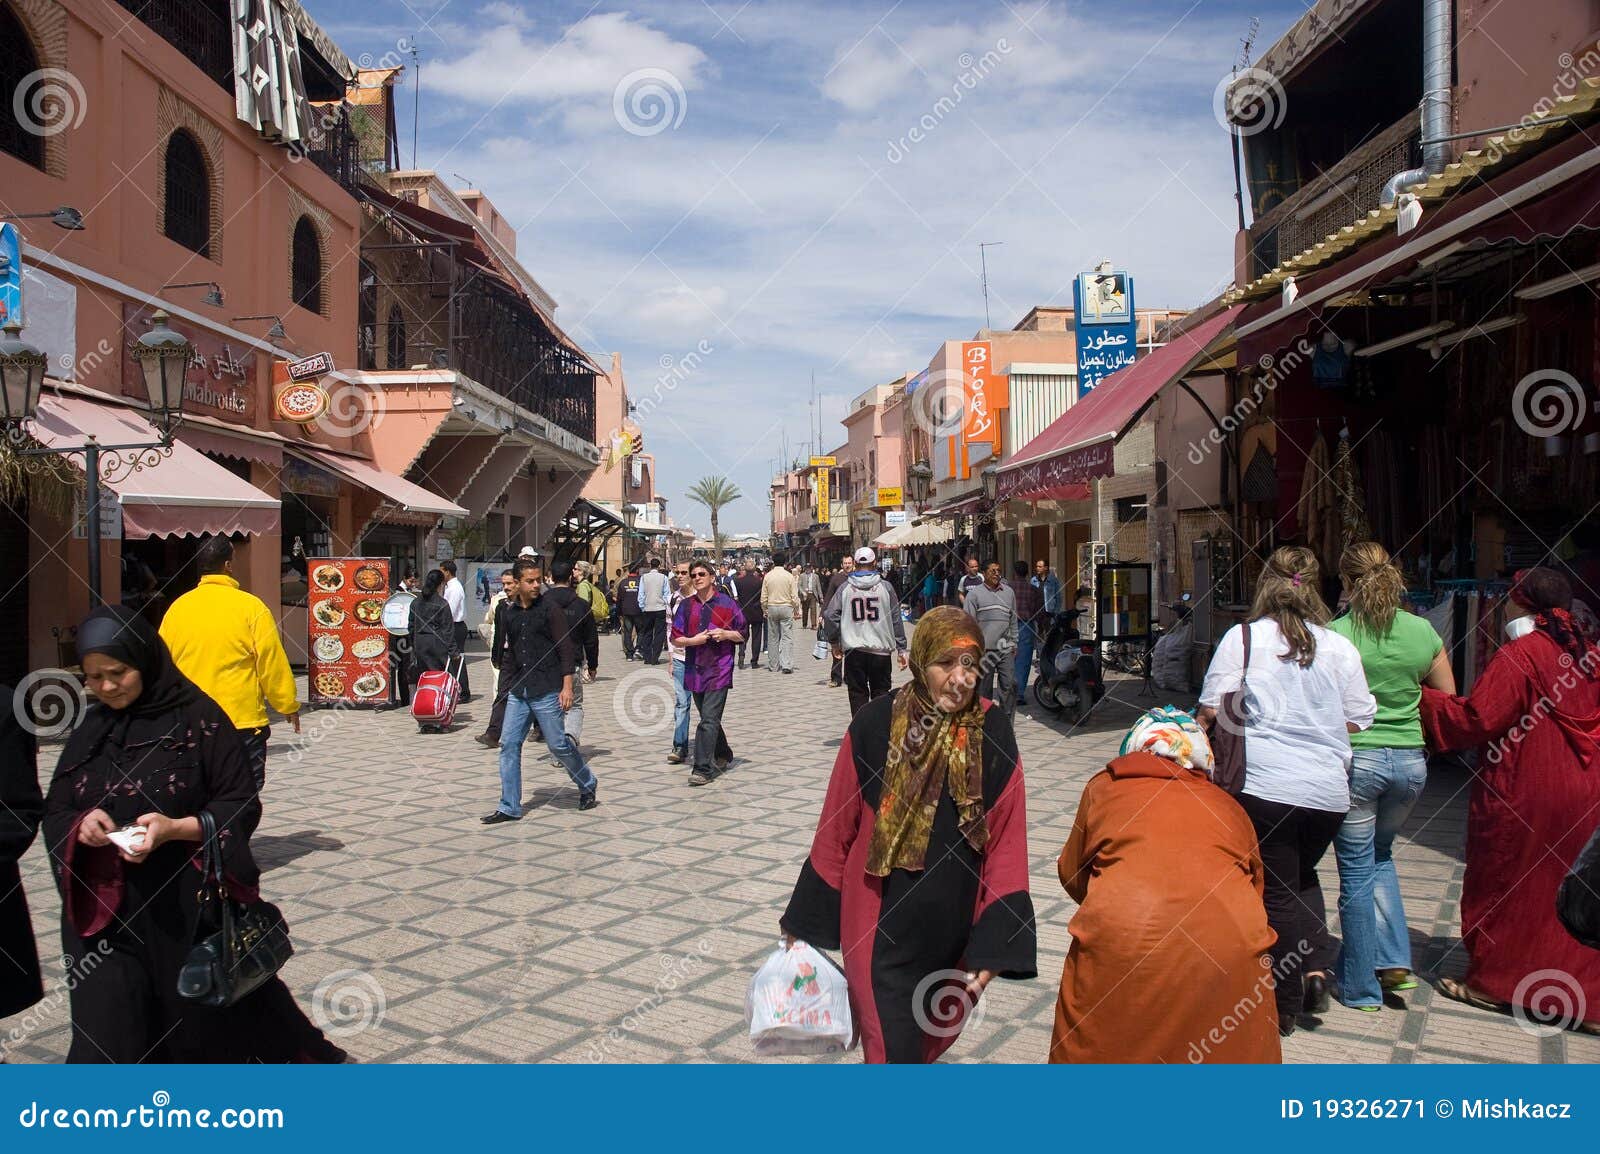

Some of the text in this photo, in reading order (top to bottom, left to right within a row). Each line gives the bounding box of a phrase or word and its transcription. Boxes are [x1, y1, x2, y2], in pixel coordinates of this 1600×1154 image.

[1082, 329, 1128, 350] عطور
[291, 355, 326, 377] PIZZA
[1080, 350, 1136, 370] صالون تجميل
[851, 597, 880, 623] 05
